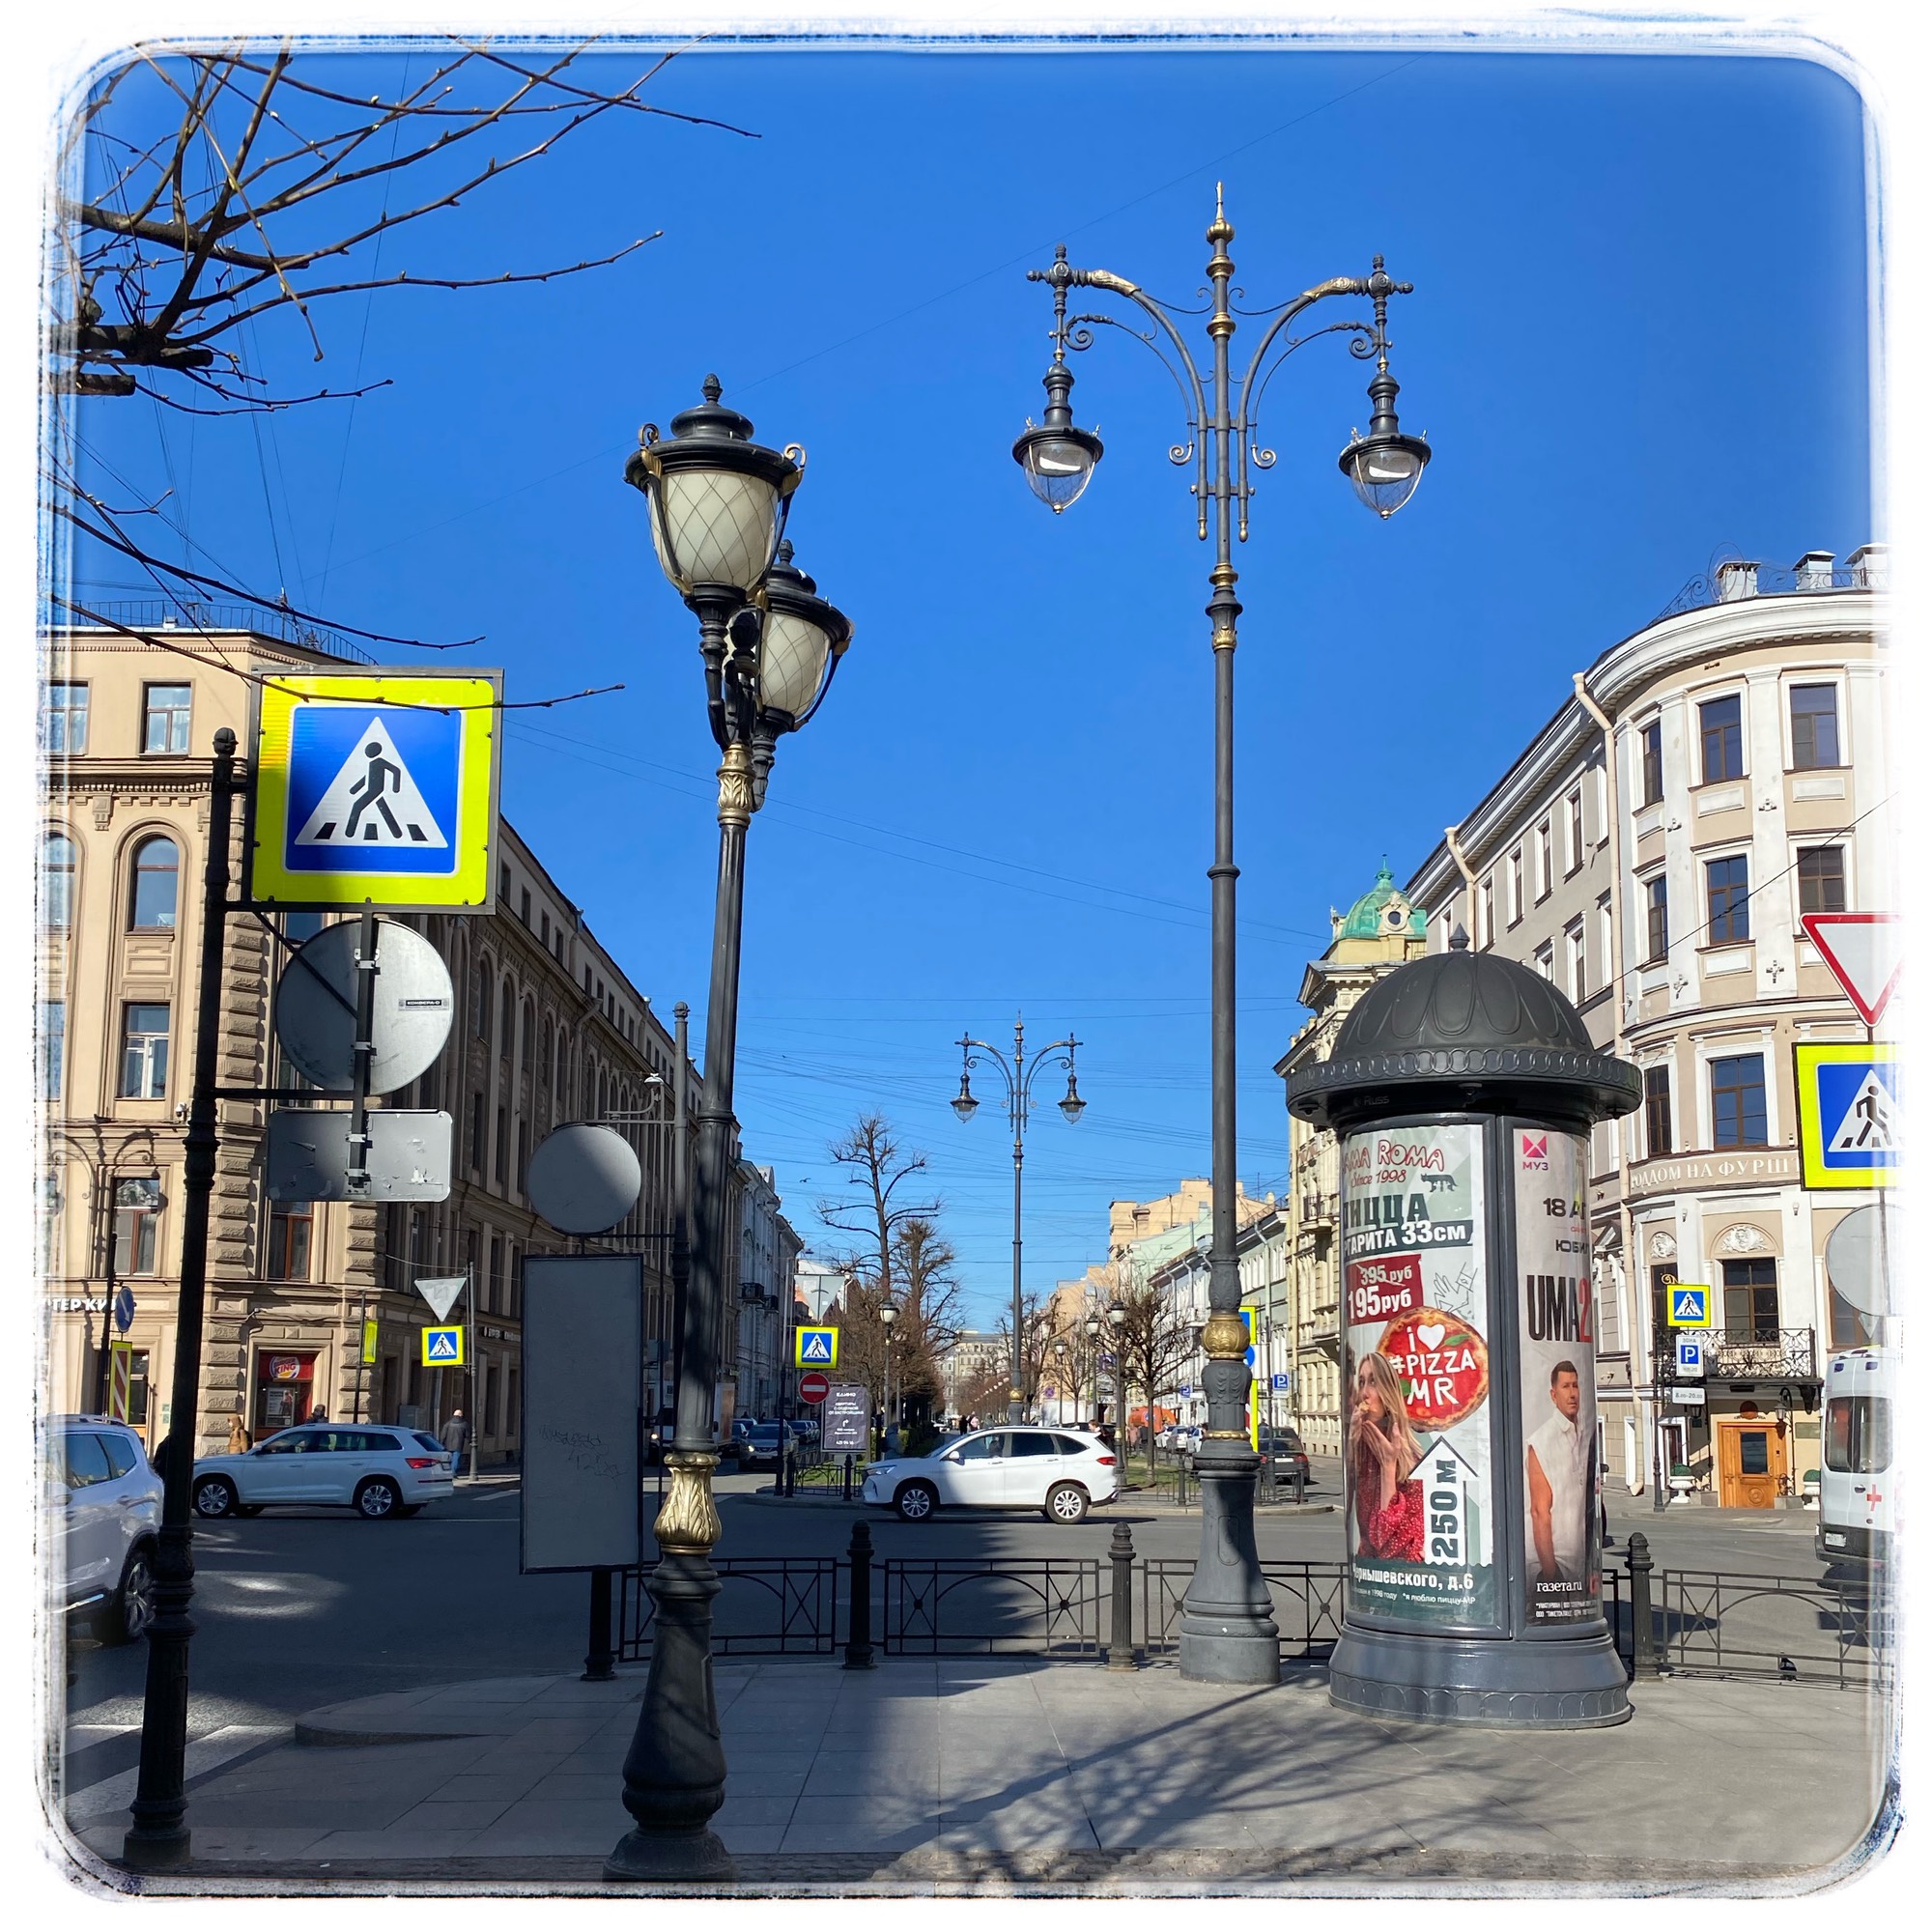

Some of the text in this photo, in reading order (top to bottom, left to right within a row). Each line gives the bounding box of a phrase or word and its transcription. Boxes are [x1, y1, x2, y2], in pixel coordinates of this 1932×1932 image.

[1342, 1139, 1444, 1174] AMA ROMA
[1522, 1161, 1548, 1171] МУЗ
[1351, 1169, 1406, 1188] Since 1998
[1631, 1165, 1682, 1189] РОДДОМ
[1687, 1163, 1713, 1179] НА
[1343, 1193, 1430, 1229] ПИЦЦА
[1543, 1198, 1566, 1217] 18
[1360, 1264, 1412, 1286] 395 руб
[1389, 1349, 1476, 1376] #PIZZA
[1685, 1347, 1696, 1362] P
[274, 1363, 296, 1376] KING
[1406, 1378, 1459, 1408] MR
[1430, 1491, 1459, 1559] 250
[1411, 1594, 1436, 1603] люблю
